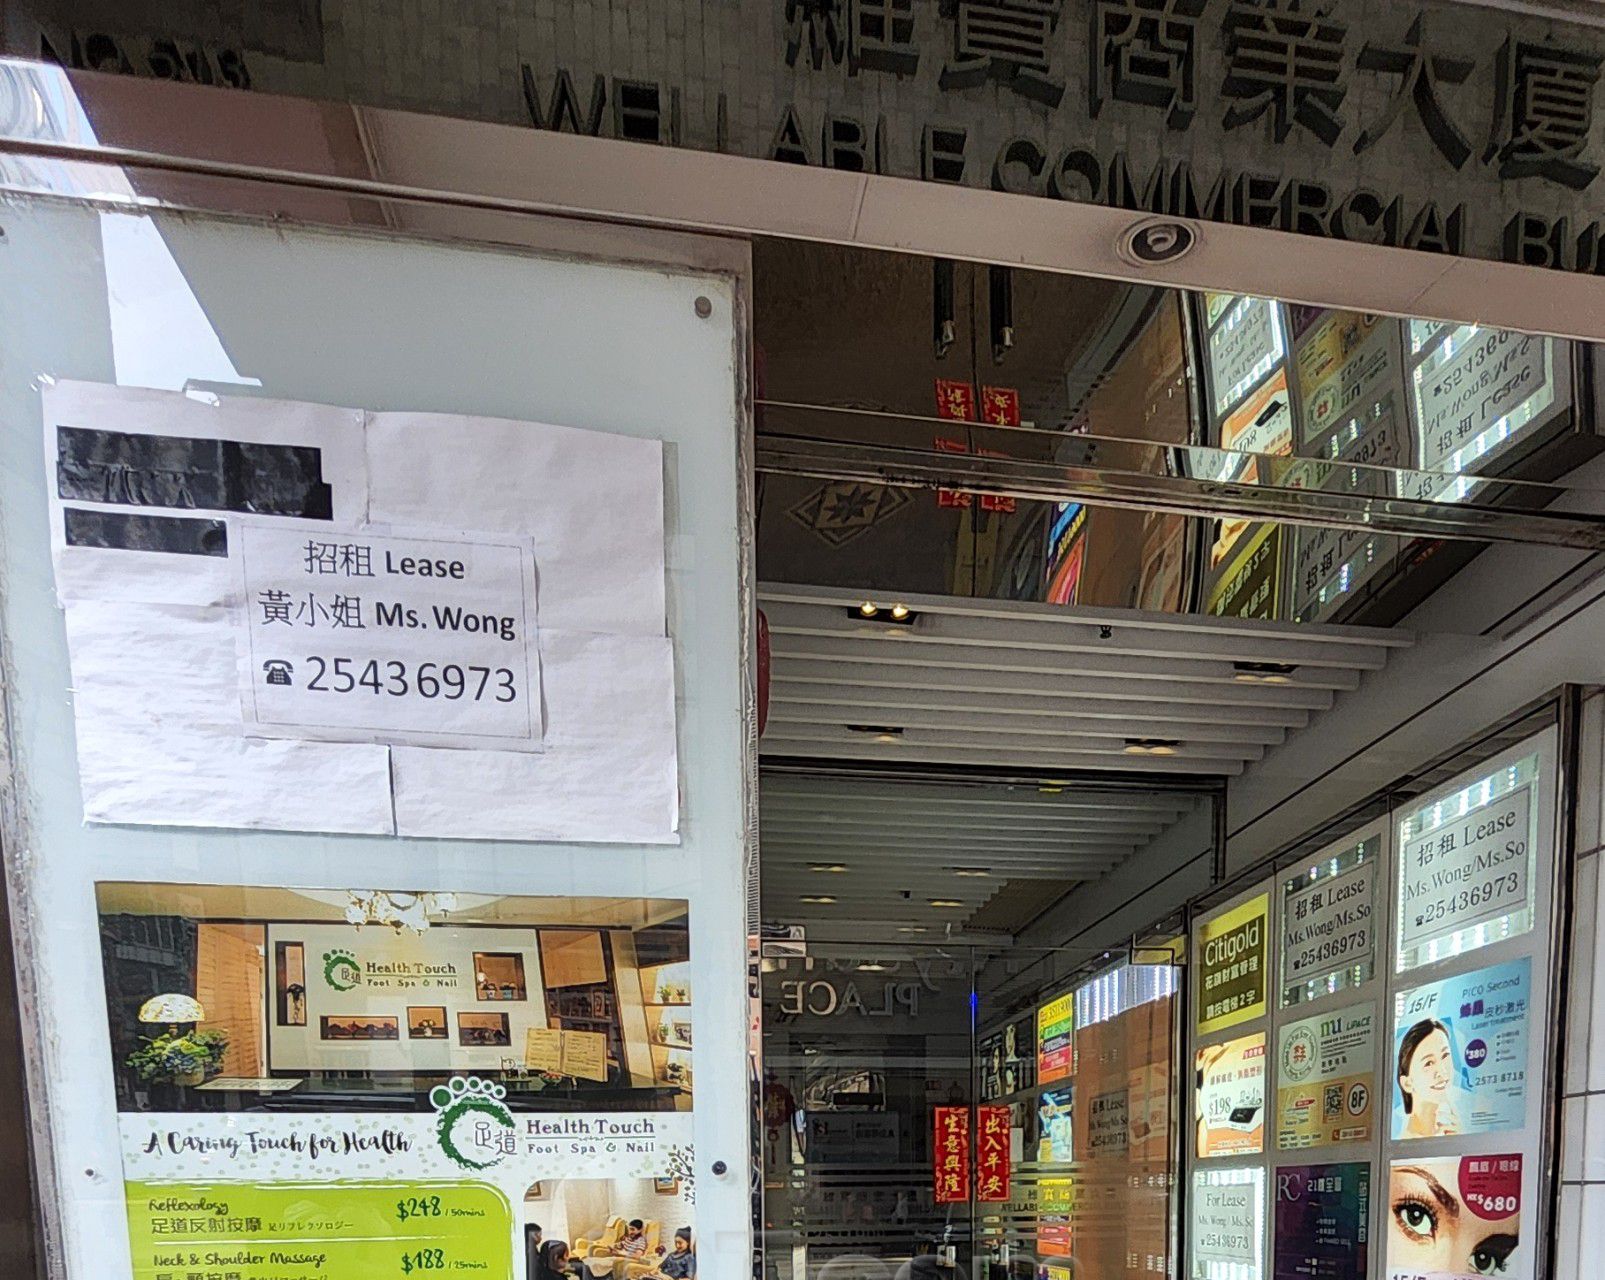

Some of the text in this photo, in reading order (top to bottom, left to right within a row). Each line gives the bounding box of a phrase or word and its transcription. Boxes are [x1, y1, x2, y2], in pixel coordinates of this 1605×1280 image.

[303, 540, 467, 581] 招租 Lease
[258, 590, 518, 643] 黃小姐 Ms. Wong
[305, 655, 519, 705] 25436973
[1417, 809, 1517, 868] 招租 Lease
[1328, 878, 1366, 908] Lease
[1424, 871, 1520, 926] 25436973
[1205, 919, 1260, 968] Citigold
[1300, 930, 1367, 970] 25436973
[366, 961, 457, 975] Health Touch
[474, 1121, 518, 1156] 足道
[526, 1117, 656, 1136] Health Touch
[142, 1129, 414, 1160] A Caring Touch for Health
[527, 1143, 560, 1155] Foot
[570, 1142, 597, 1156] Spa
[626, 1141, 656, 1154] Nail
[984, 1115, 1003, 1195] 出入平安
[148, 1197, 229, 1216] Reflexology
[396, 1195, 442, 1222] $248
[1222, 1192, 1247, 1208] Lease
[151, 1216, 263, 1236] 足道反射按摩
[153, 1252, 187, 1267] Neck
[204, 1251, 265, 1266] Shoulder
[269, 1252, 327, 1269] Massage
[401, 1248, 445, 1275] $188
